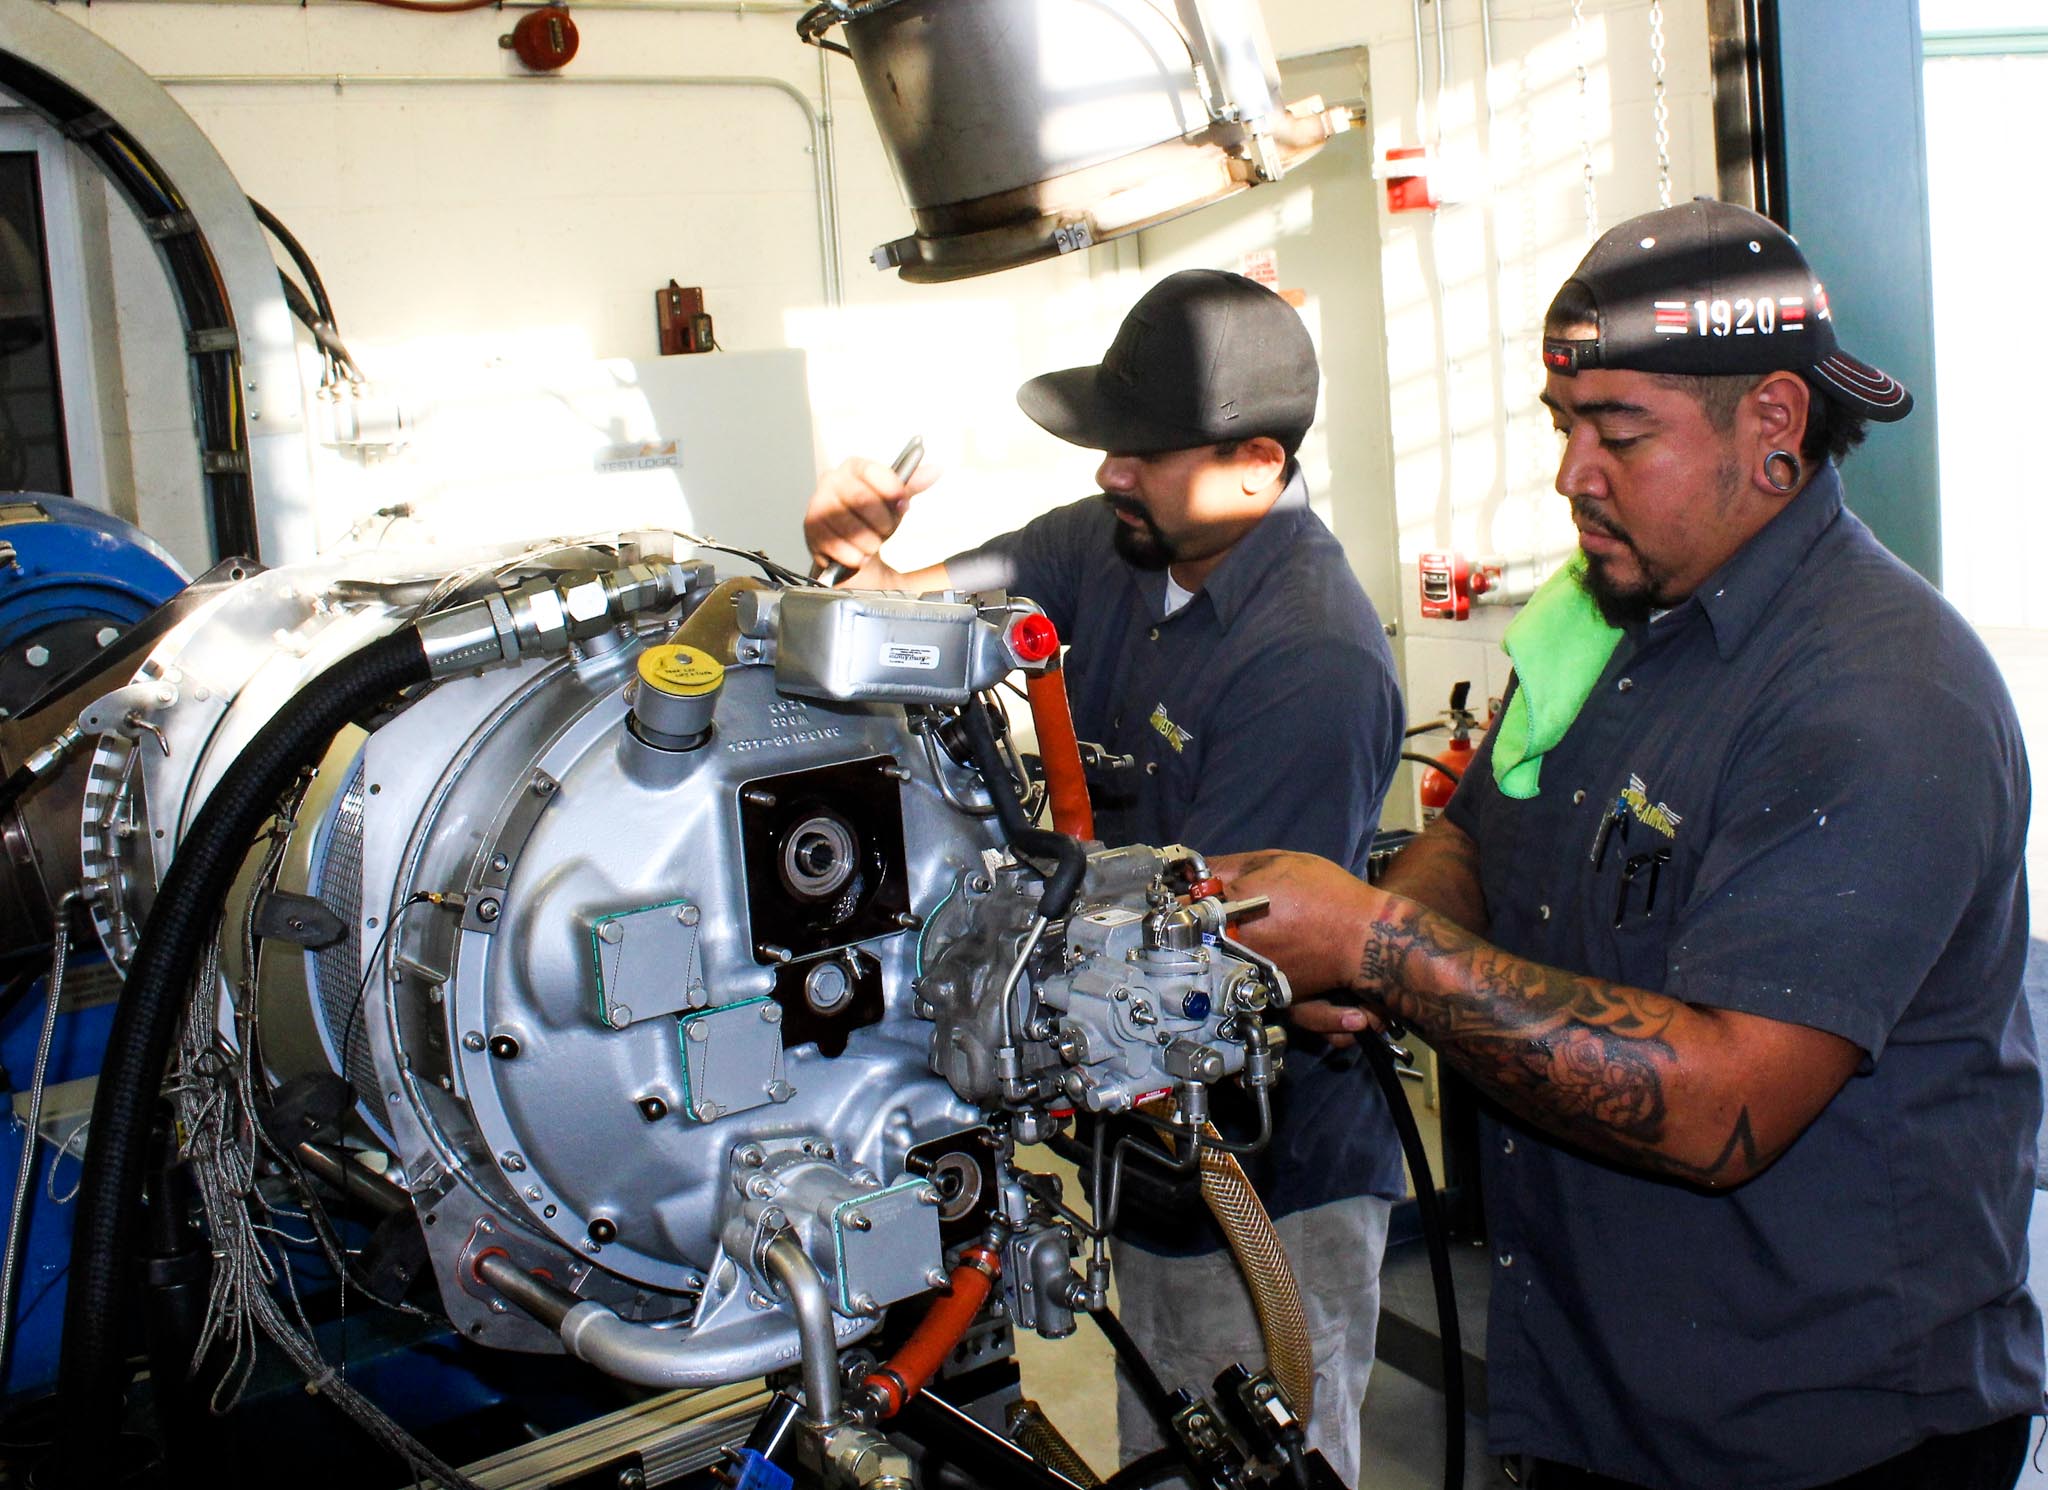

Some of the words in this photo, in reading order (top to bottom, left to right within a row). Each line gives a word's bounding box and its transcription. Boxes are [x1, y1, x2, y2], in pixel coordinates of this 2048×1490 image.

[1694, 296, 1776, 337] 1920
[600, 459, 634, 473] TEST
[638, 455, 678, 470] LOGIC
